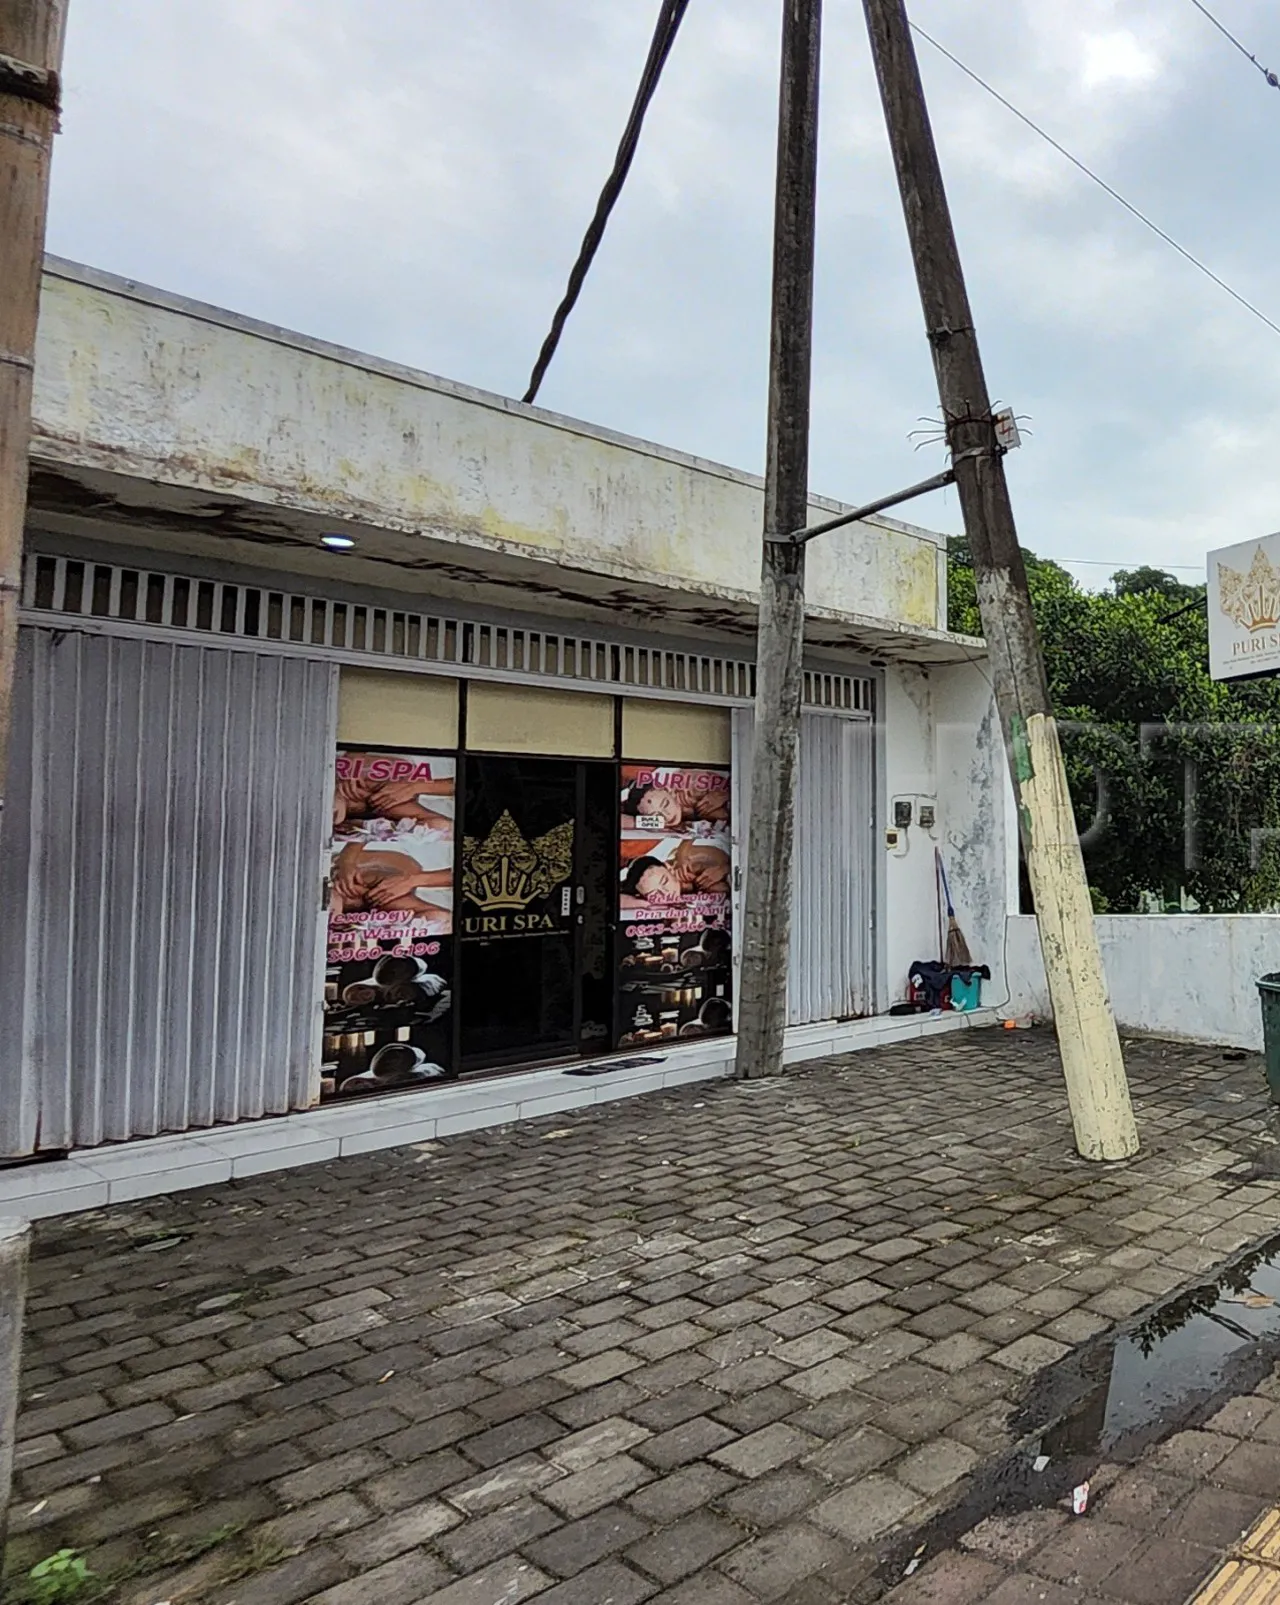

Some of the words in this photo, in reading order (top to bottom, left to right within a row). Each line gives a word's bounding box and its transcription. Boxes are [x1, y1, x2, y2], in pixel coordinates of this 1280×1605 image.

[1233, 636, 1266, 656] PURI
[368, 759, 434, 782] SPA
[636, 770, 691, 790] PURI
[362, 926, 429, 940] Wanita
[461, 915, 507, 933] URI
[513, 914, 554, 930] SPA
